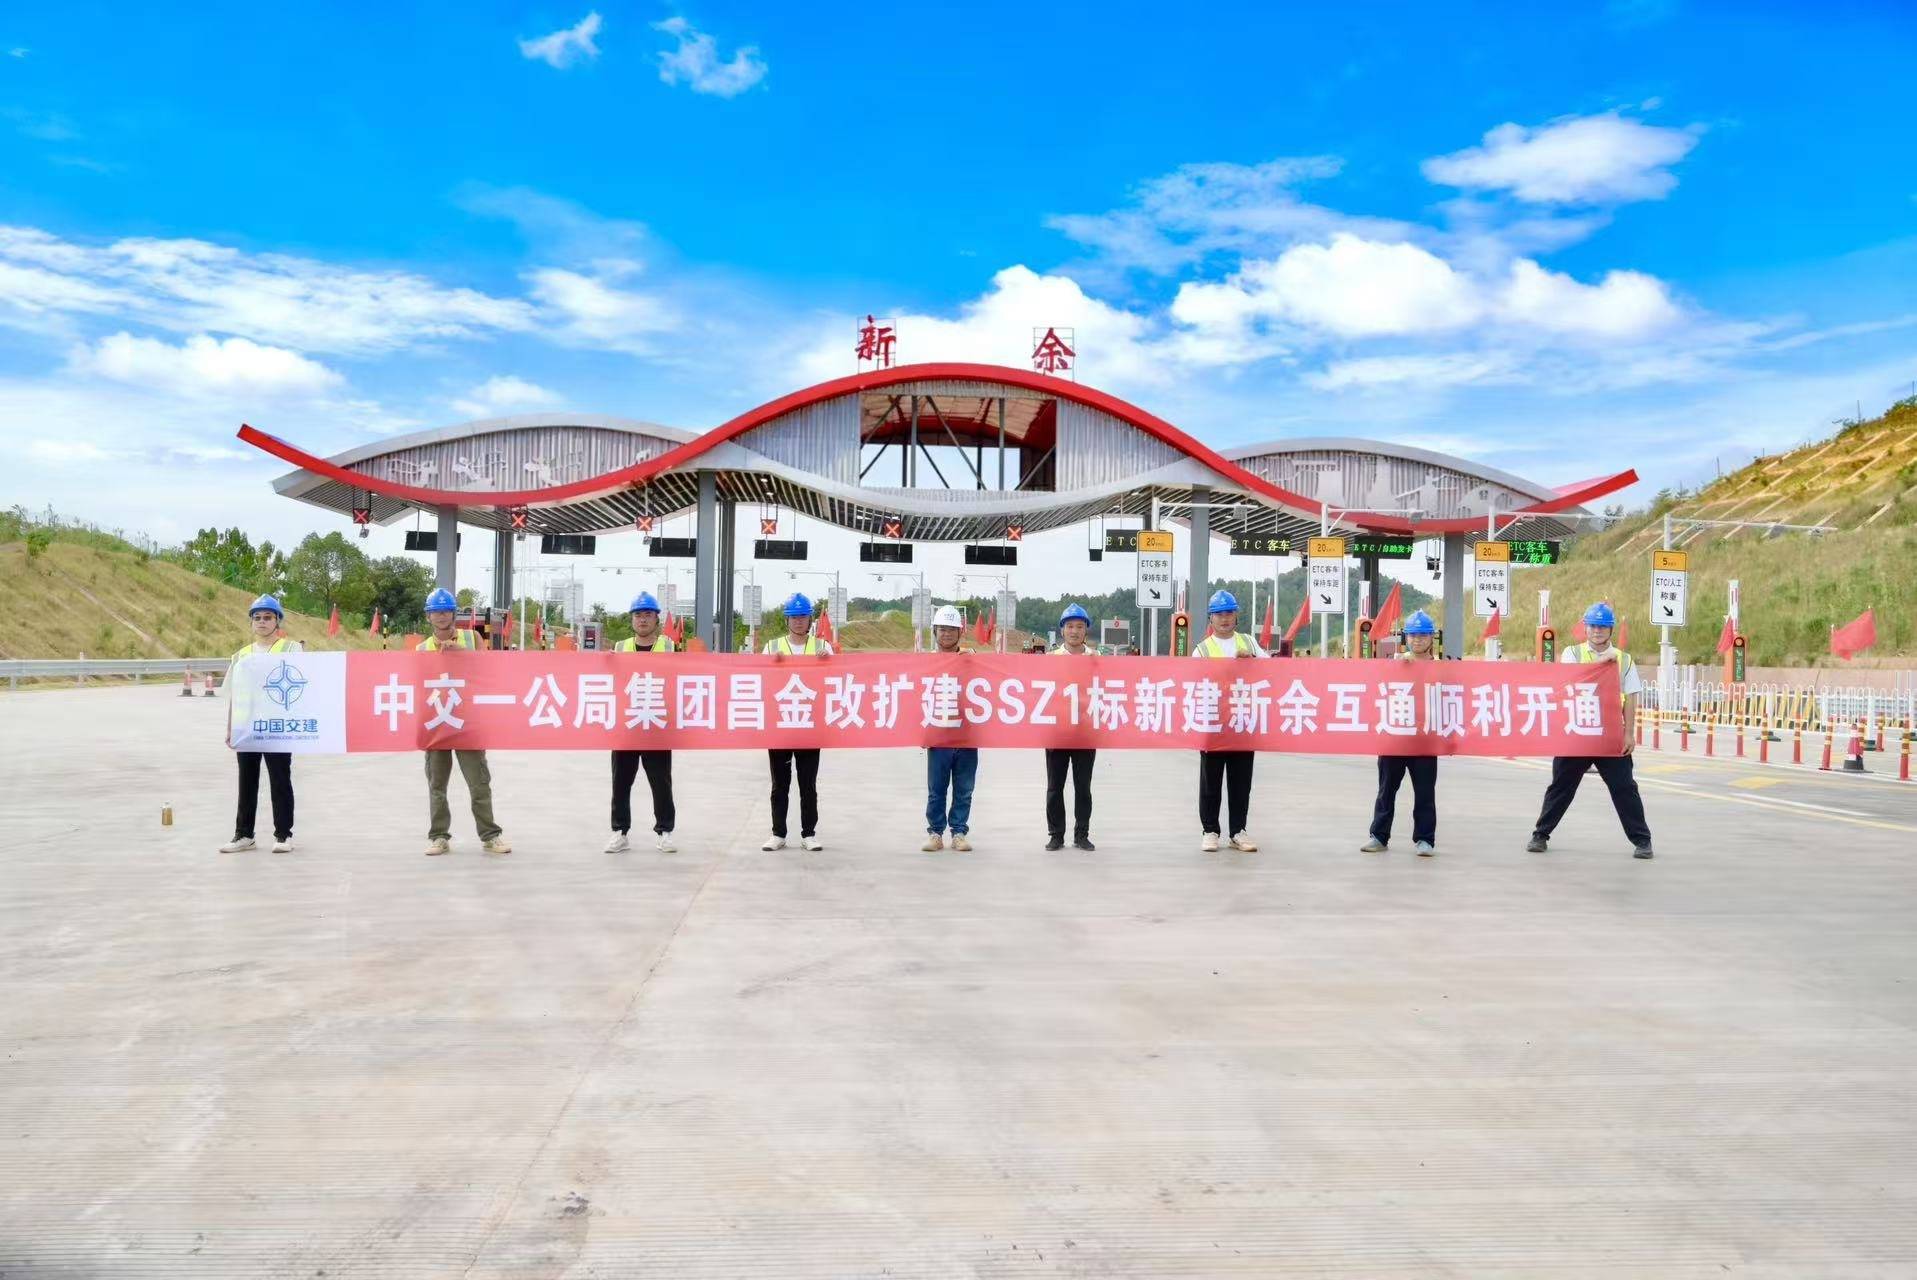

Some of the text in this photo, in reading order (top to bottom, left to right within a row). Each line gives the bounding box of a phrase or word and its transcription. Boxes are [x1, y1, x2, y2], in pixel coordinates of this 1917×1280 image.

[1146, 537, 1156, 546] 20
[1317, 543, 1327, 552] 20
[1483, 547, 1492, 556] 20
[1508, 541, 1548, 553] ETC客车
[1141, 559, 1169, 568] ETC客车
[1312, 565, 1339, 574] ETC客车
[1478, 569, 1504, 577] ETC客车
[1142, 573, 1169, 583] 保持车距
[1656, 577, 1682, 587] ETC/人工
[1313, 579, 1339, 588] 保持车距
[1479, 583, 1505, 592] 保持车距
[1660, 591, 1677, 601] 称重
[373, 672, 1604, 738] 中交一公局集团昌金改扩建SSZ1标新建新余互通顺利开通
[254, 718, 318, 733] 中国交建
